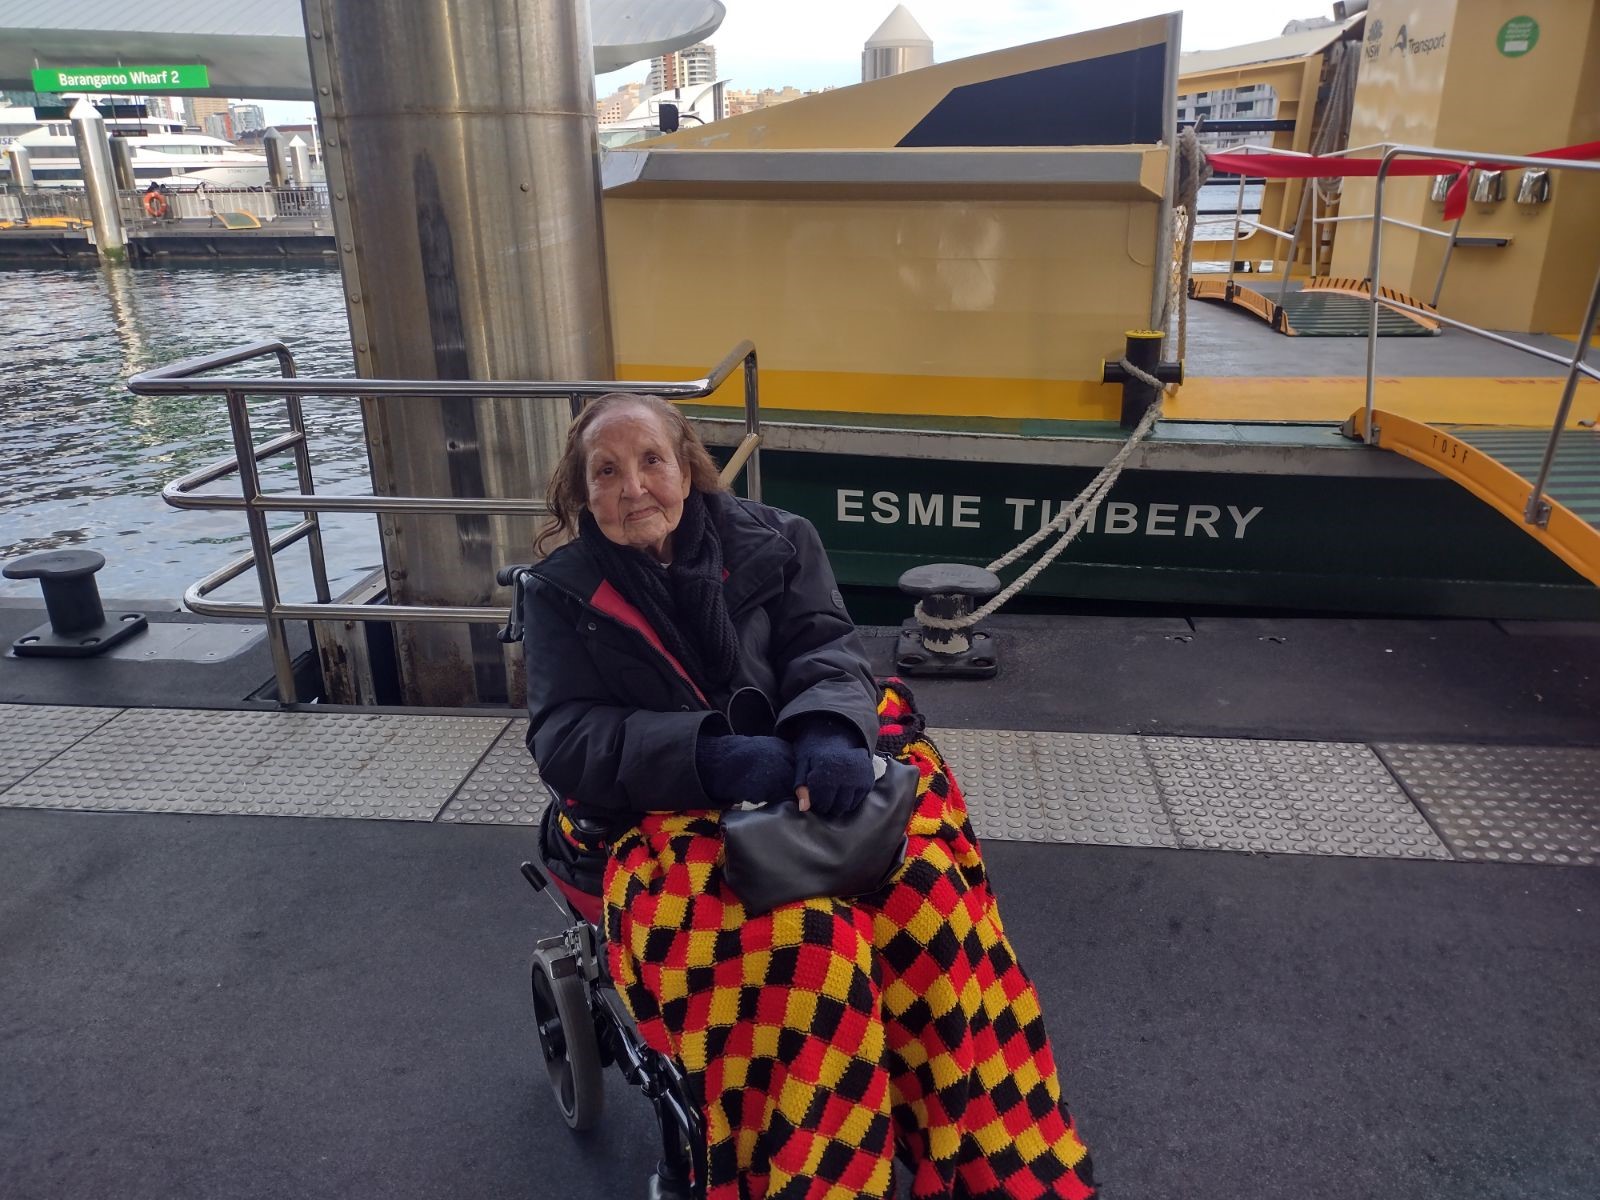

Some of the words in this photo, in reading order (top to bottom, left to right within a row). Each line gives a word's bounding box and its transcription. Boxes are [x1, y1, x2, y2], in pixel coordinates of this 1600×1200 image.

[1365, 44, 1380, 58] NSW
[1408, 32, 1447, 56] Transport
[58, 73, 127, 88] Barangaroo
[129, 71, 168, 85] Wharf
[170, 70, 180, 83] 2
[836, 489, 981, 528] ESME
